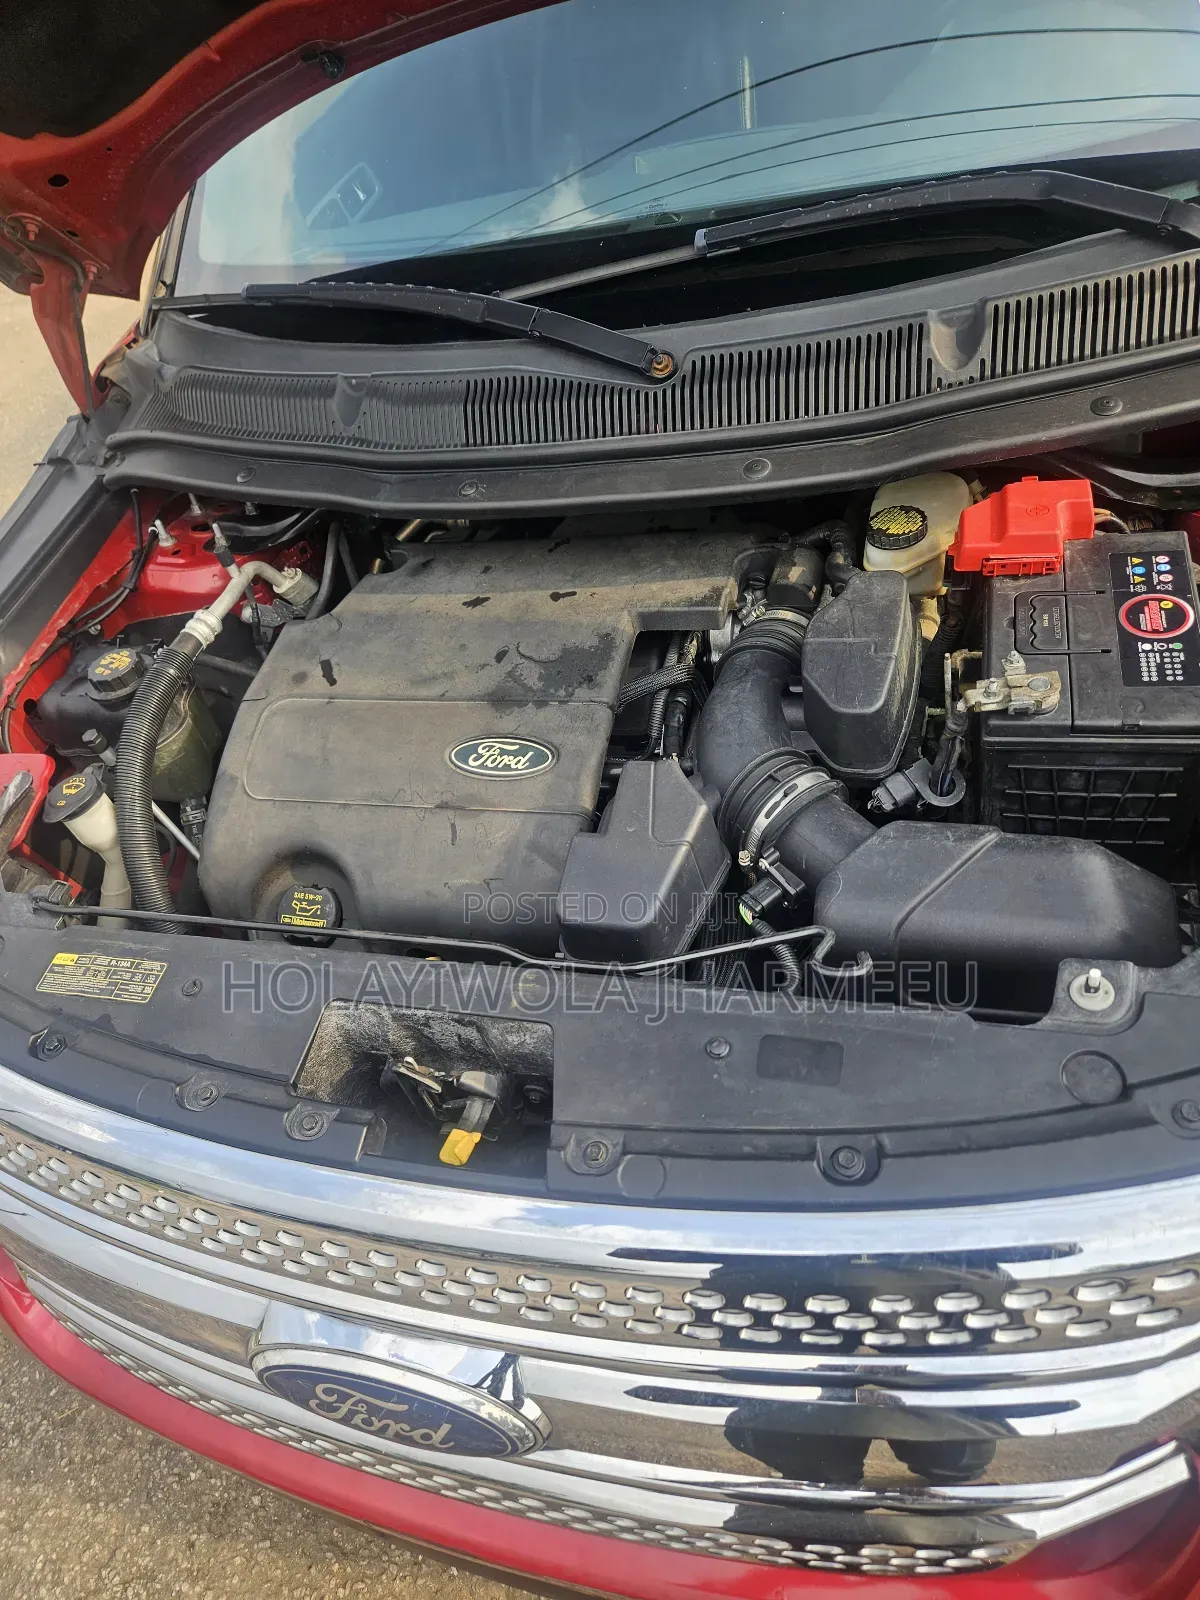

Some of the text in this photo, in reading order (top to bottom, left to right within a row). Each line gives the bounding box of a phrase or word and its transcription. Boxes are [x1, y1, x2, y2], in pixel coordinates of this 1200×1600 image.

[468, 742, 534, 769] Ford
[293, 891, 322, 901] SAE 5W-20
[308, 1383, 455, 1448] Ford
